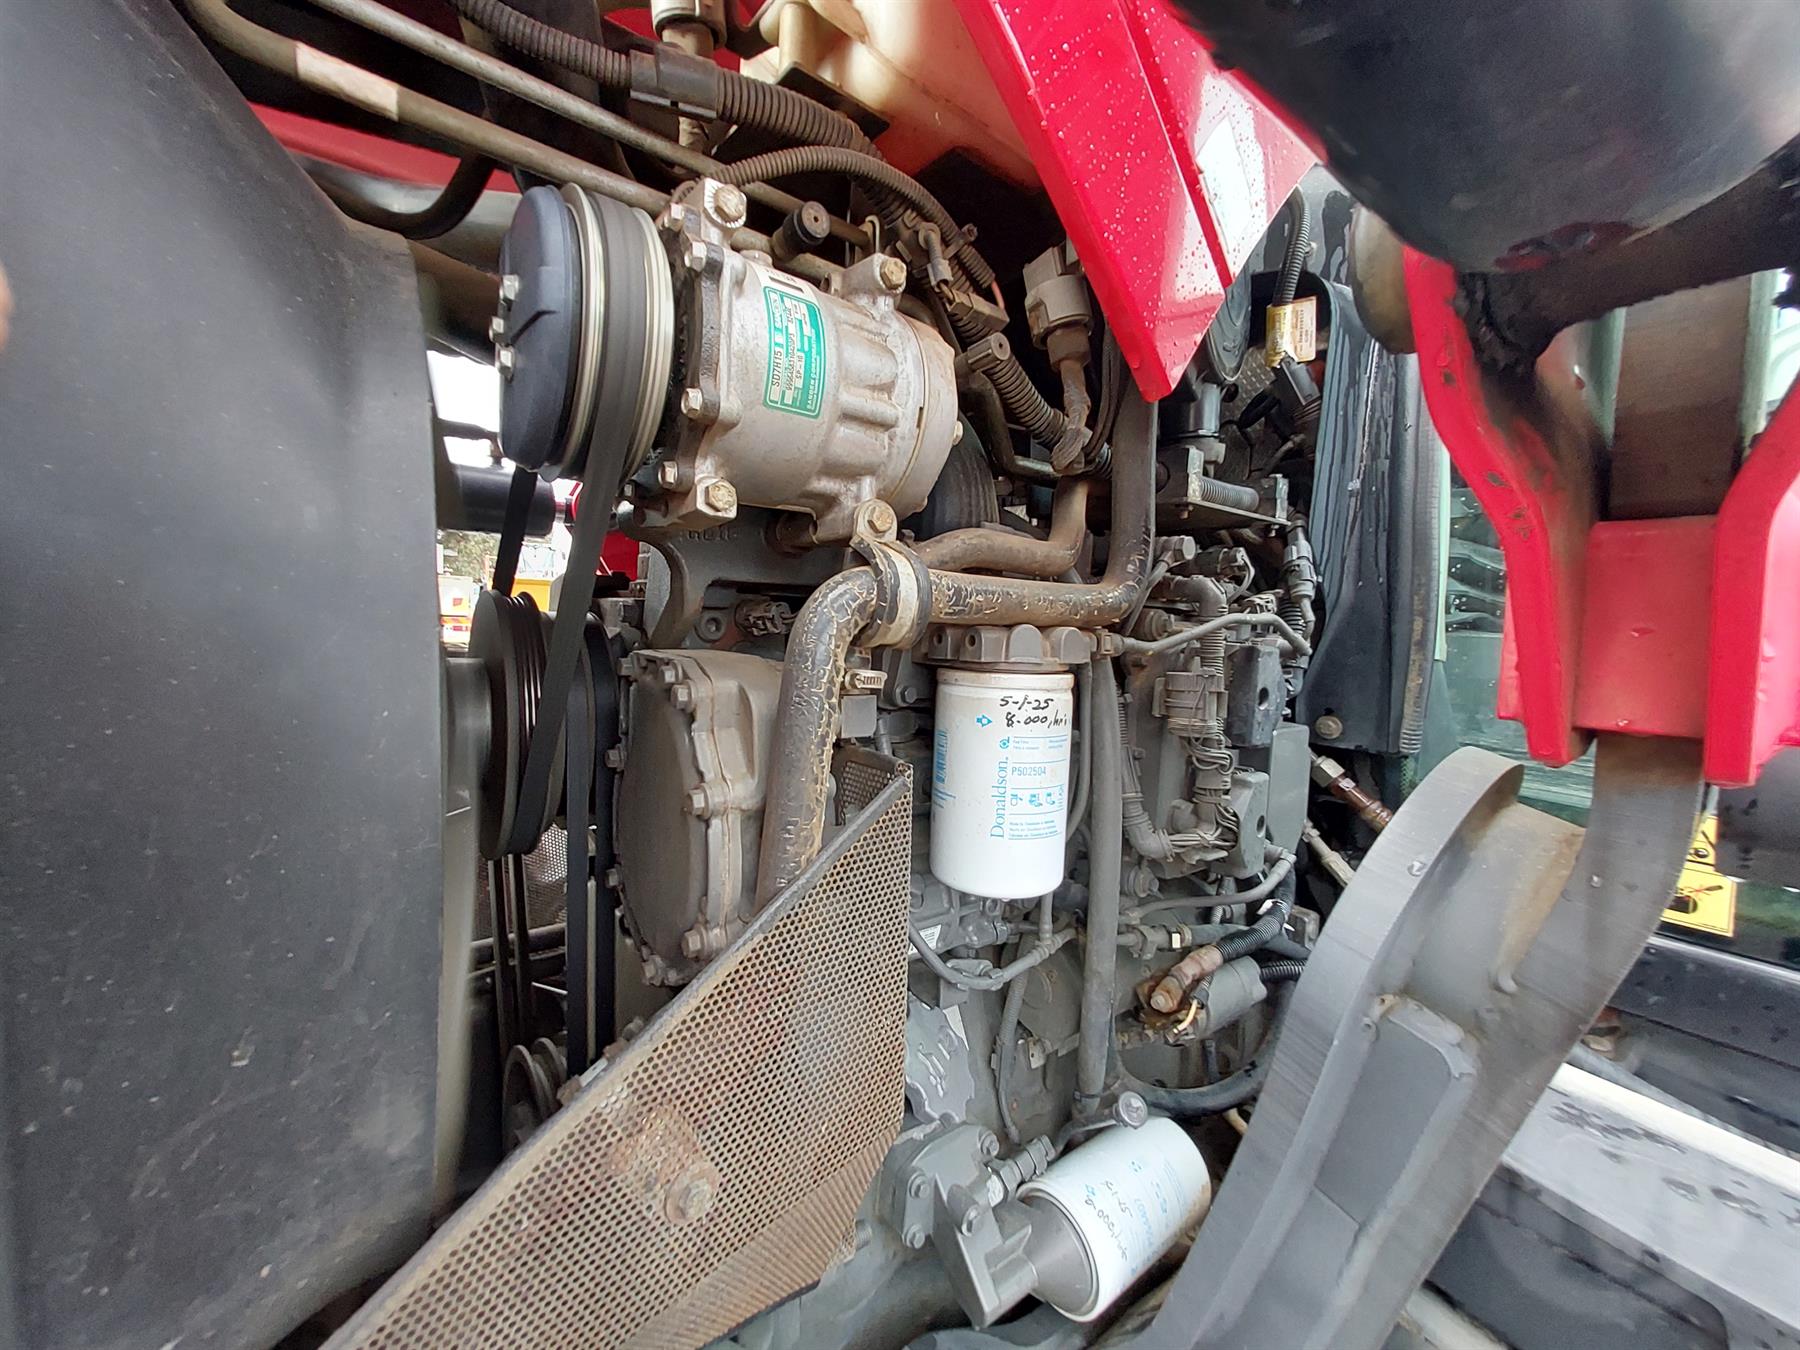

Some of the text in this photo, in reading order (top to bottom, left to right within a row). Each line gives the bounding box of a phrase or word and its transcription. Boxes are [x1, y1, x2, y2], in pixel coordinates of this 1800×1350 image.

[771, 349, 783, 388] SD7H15
[999, 693, 1054, 711] 5-1-25
[1011, 766, 1047, 777] P502504
